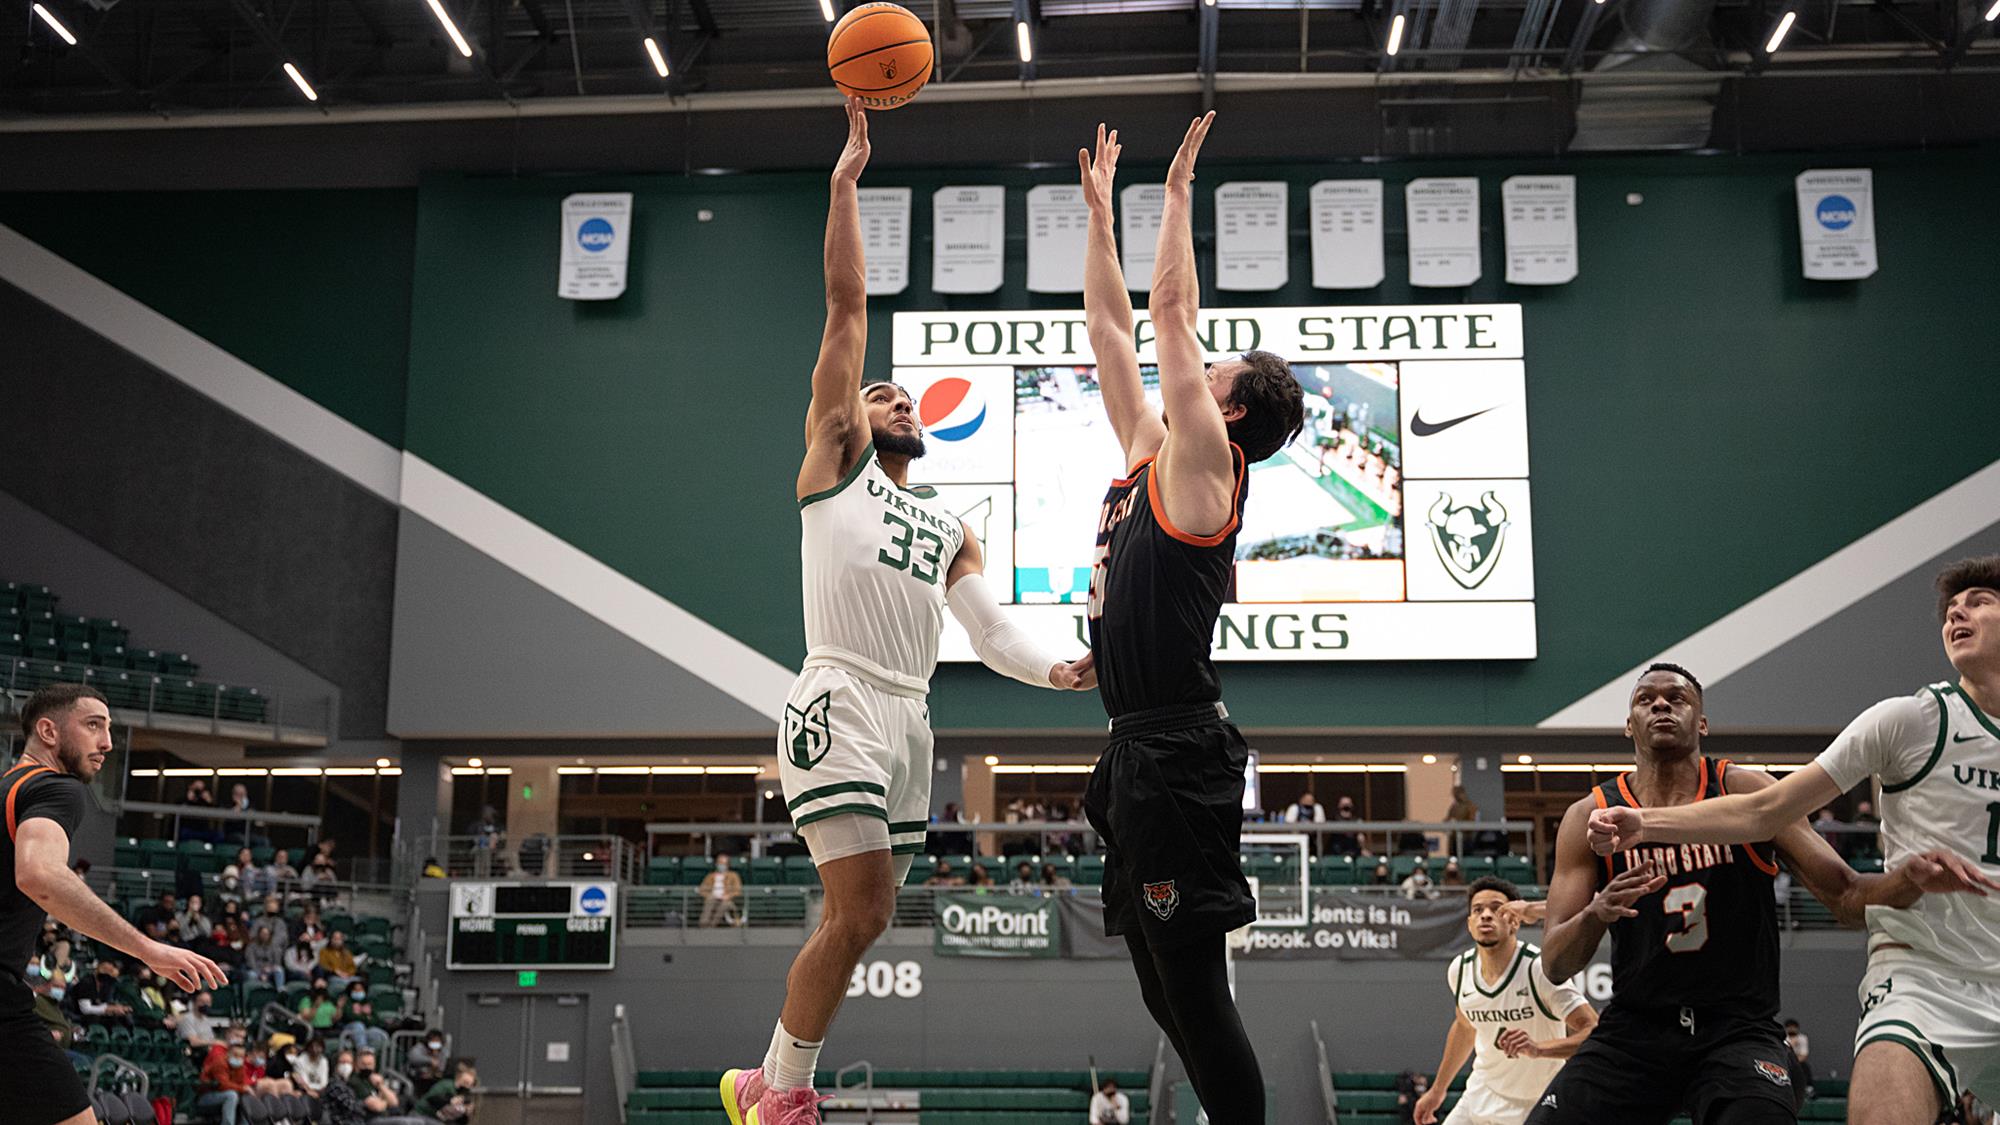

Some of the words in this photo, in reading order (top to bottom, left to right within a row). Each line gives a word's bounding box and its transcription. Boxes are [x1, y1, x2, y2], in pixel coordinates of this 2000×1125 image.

[858, 81, 926, 107] Wilson
[920, 316, 1262, 356] PORTAND
[1298, 314, 1497, 351] STATE
[867, 478, 963, 549] VIKINGS
[877, 511, 944, 586] 33
[459, 918, 496, 933] HOME
[566, 918, 608, 932] GUEST
[942, 904, 1050, 936] OnPoint
[1368, 904, 1388, 924] is
[1391, 904, 1412, 925] in
[1663, 882, 1709, 954] 3
[1313, 929, 1345, 948] Go
[1346, 929, 1398, 949] Viks!
[846, 960, 923, 998] 308
[1465, 1006, 1535, 1023] VIKINGS
